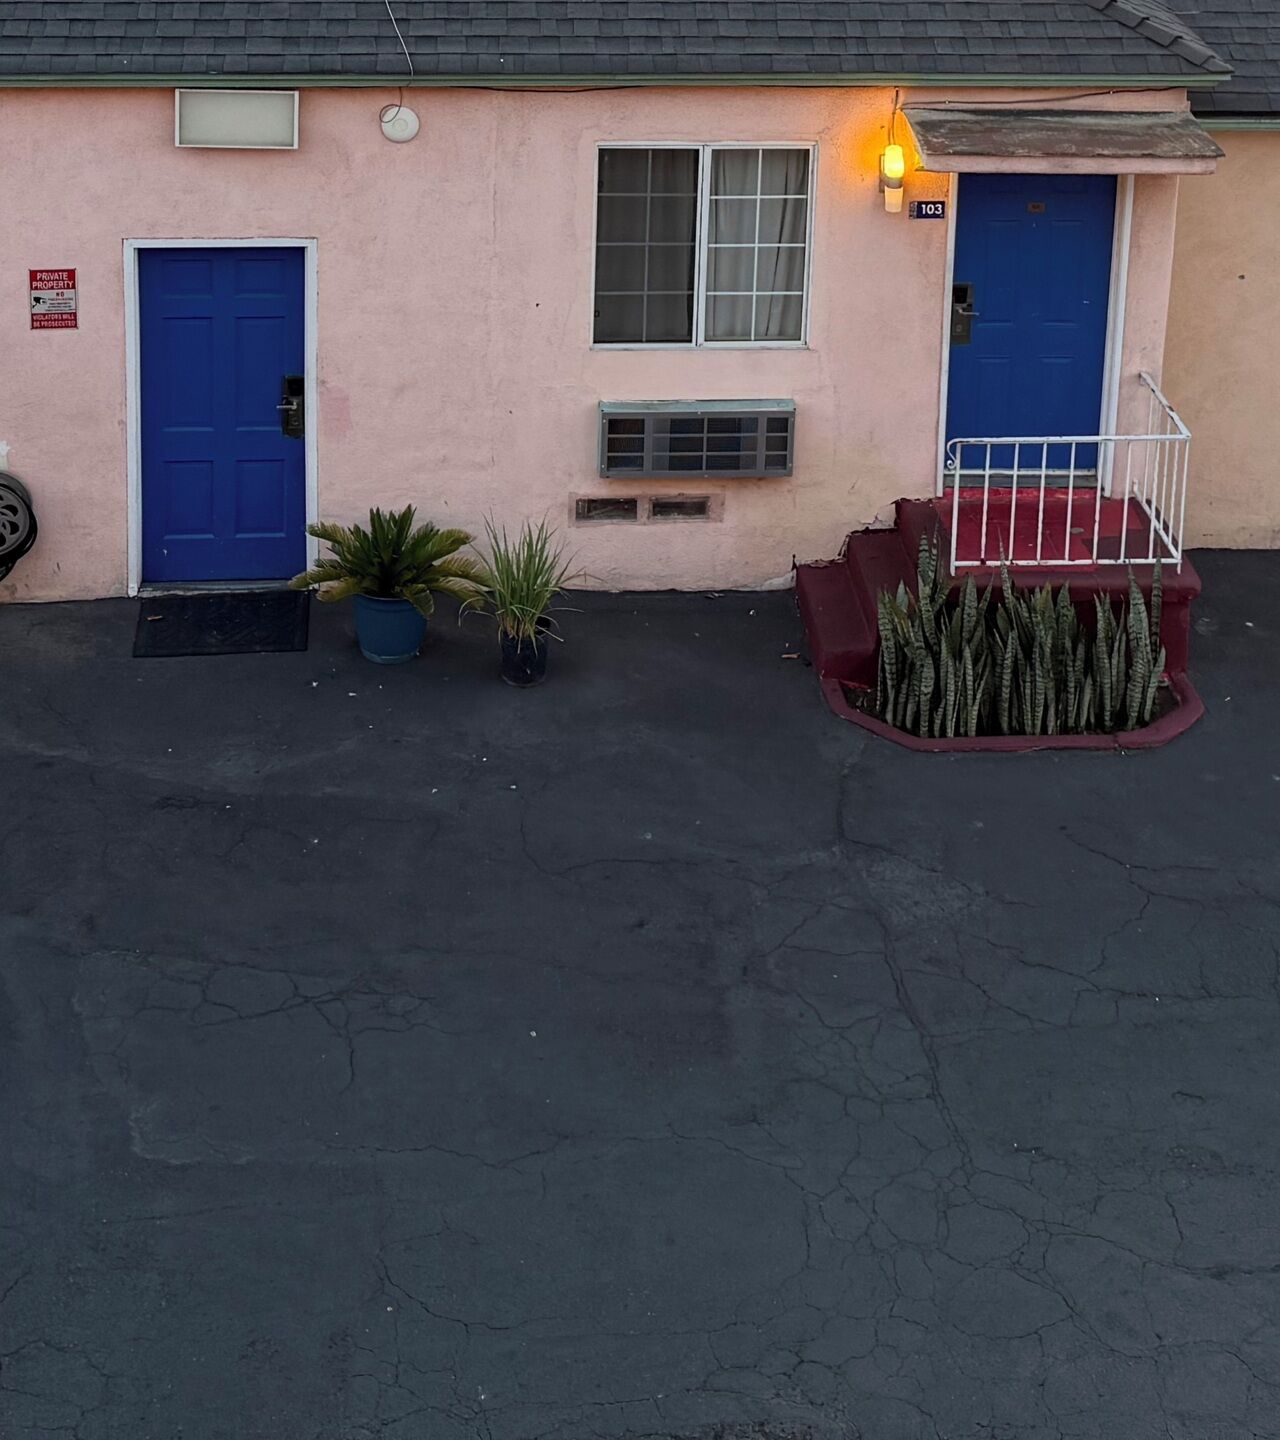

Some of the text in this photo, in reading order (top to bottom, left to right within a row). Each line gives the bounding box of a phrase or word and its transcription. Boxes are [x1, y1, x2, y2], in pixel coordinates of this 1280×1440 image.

[921, 204, 943, 214] 103
[36, 272, 68, 280] PRIVATE
[32, 280, 73, 289] PROPERTY
